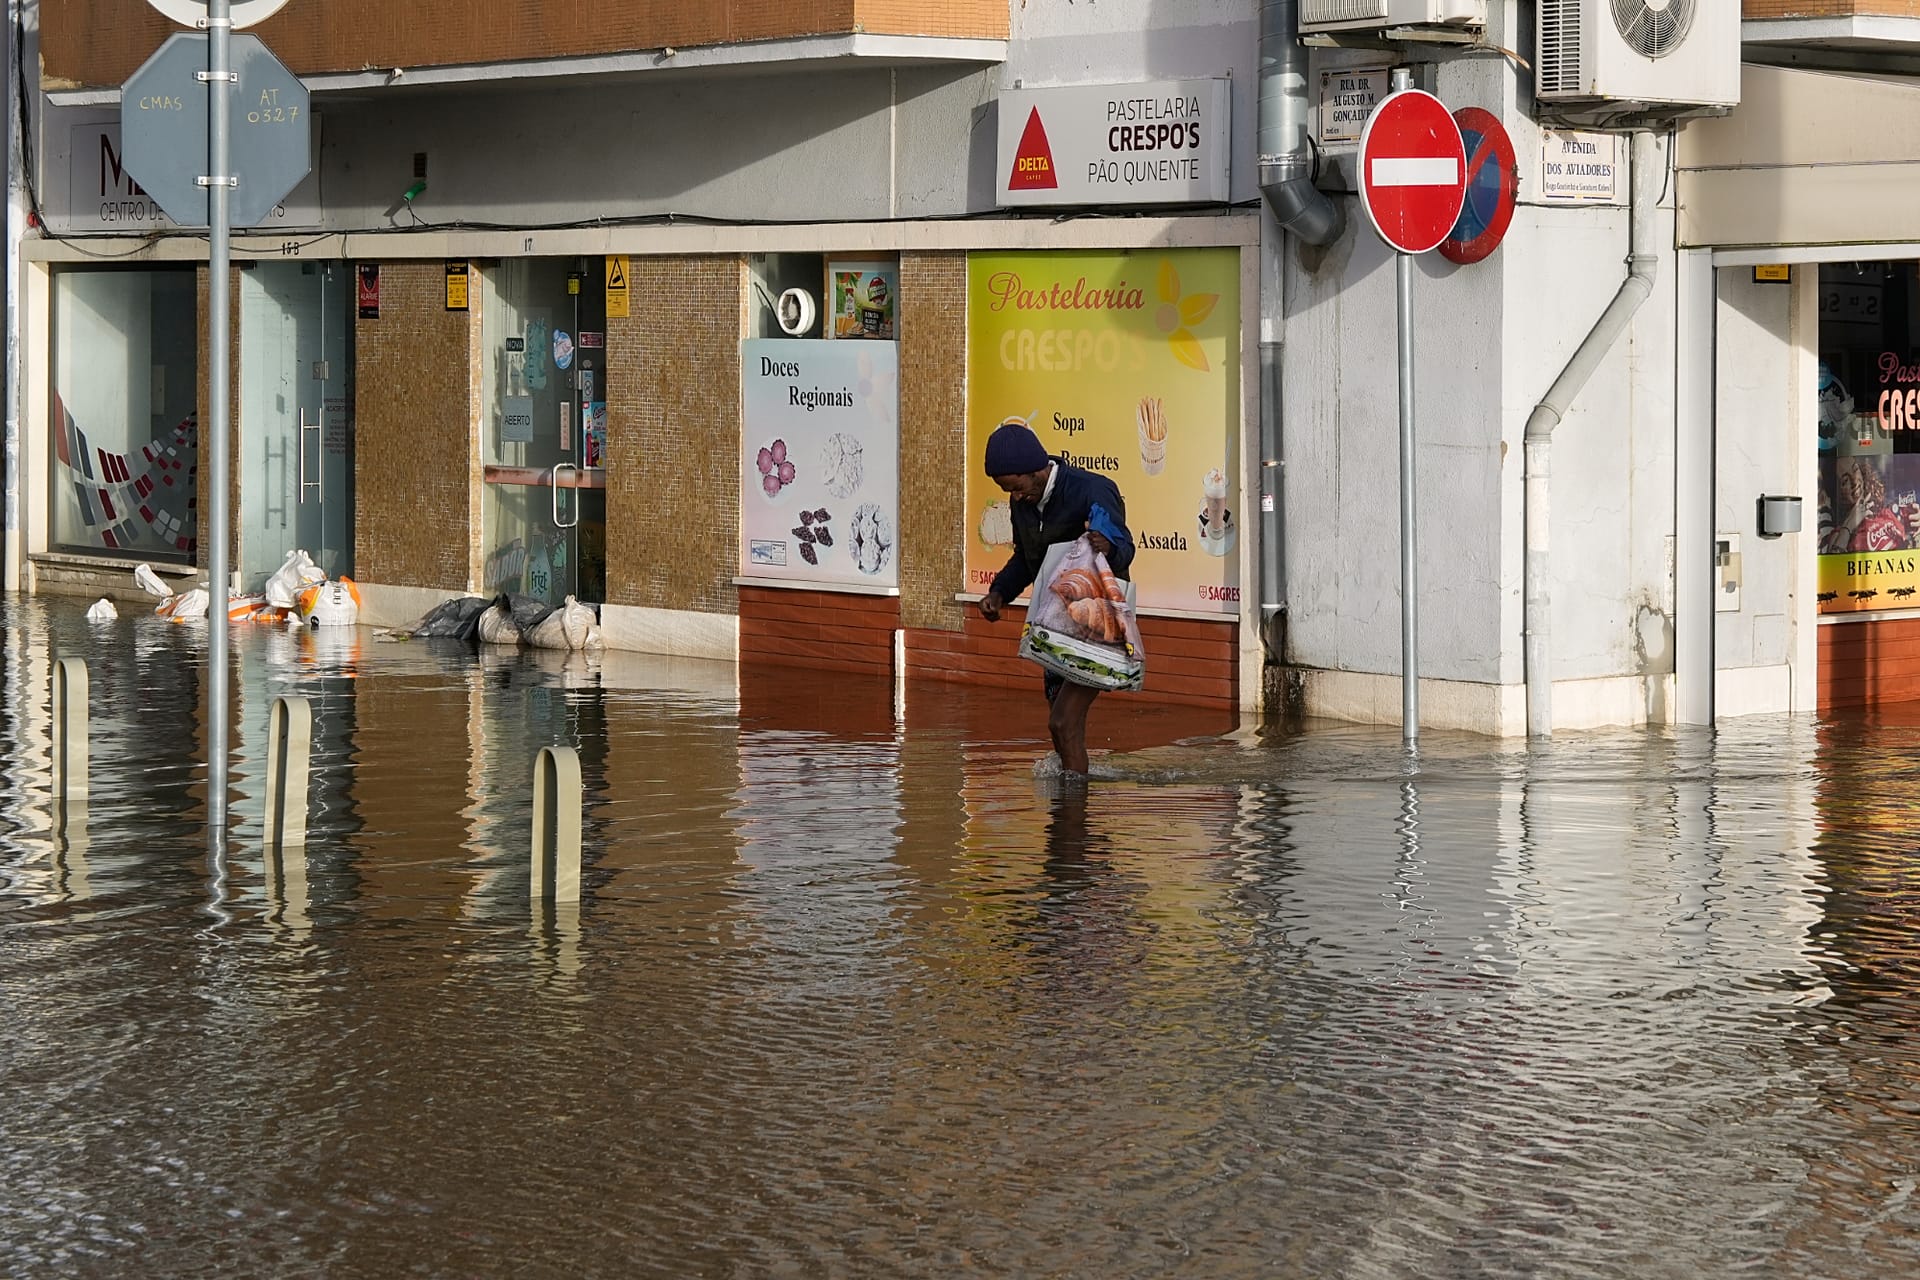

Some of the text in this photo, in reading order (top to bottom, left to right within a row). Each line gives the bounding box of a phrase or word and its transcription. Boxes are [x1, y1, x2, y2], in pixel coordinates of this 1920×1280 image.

[1340, 79, 1355, 91] RUA
[139, 96, 182, 111] CMAS
[260, 89, 279, 106] AT
[1333, 93, 1365, 107] AUGUSTO
[247, 106, 299, 123] 0327
[1107, 96, 1201, 121] PASTELARIA
[1333, 109, 1374, 125] GONÇALVE
[1108, 122, 1200, 152] CRESPO'S
[1561, 141, 1597, 154] AVENIDA
[1018, 157, 1049, 172] DELTA
[1088, 158, 1199, 185] PÃO QUNENTE
[1546, 163, 1611, 177] DOS AVIADORES
[100, 201, 145, 222] CENTRO
[524, 237, 533, 252] 17
[988, 271, 1145, 312] Pastelaria
[1000, 328, 1147, 372] CRESPO'S
[760, 356, 800, 377] Doces
[789, 385, 853, 412] Regionais
[1878, 388, 1920, 430] CRE
[504, 414, 530, 426] ABERTO
[1053, 411, 1085, 436] Sopa
[1061, 450, 1119, 471] Baguetes
[1137, 530, 1187, 551] Assada
[1847, 557, 1915, 577] BIFANAS
[980, 570, 996, 584] SAG
[1208, 585, 1240, 602] SAGRES
